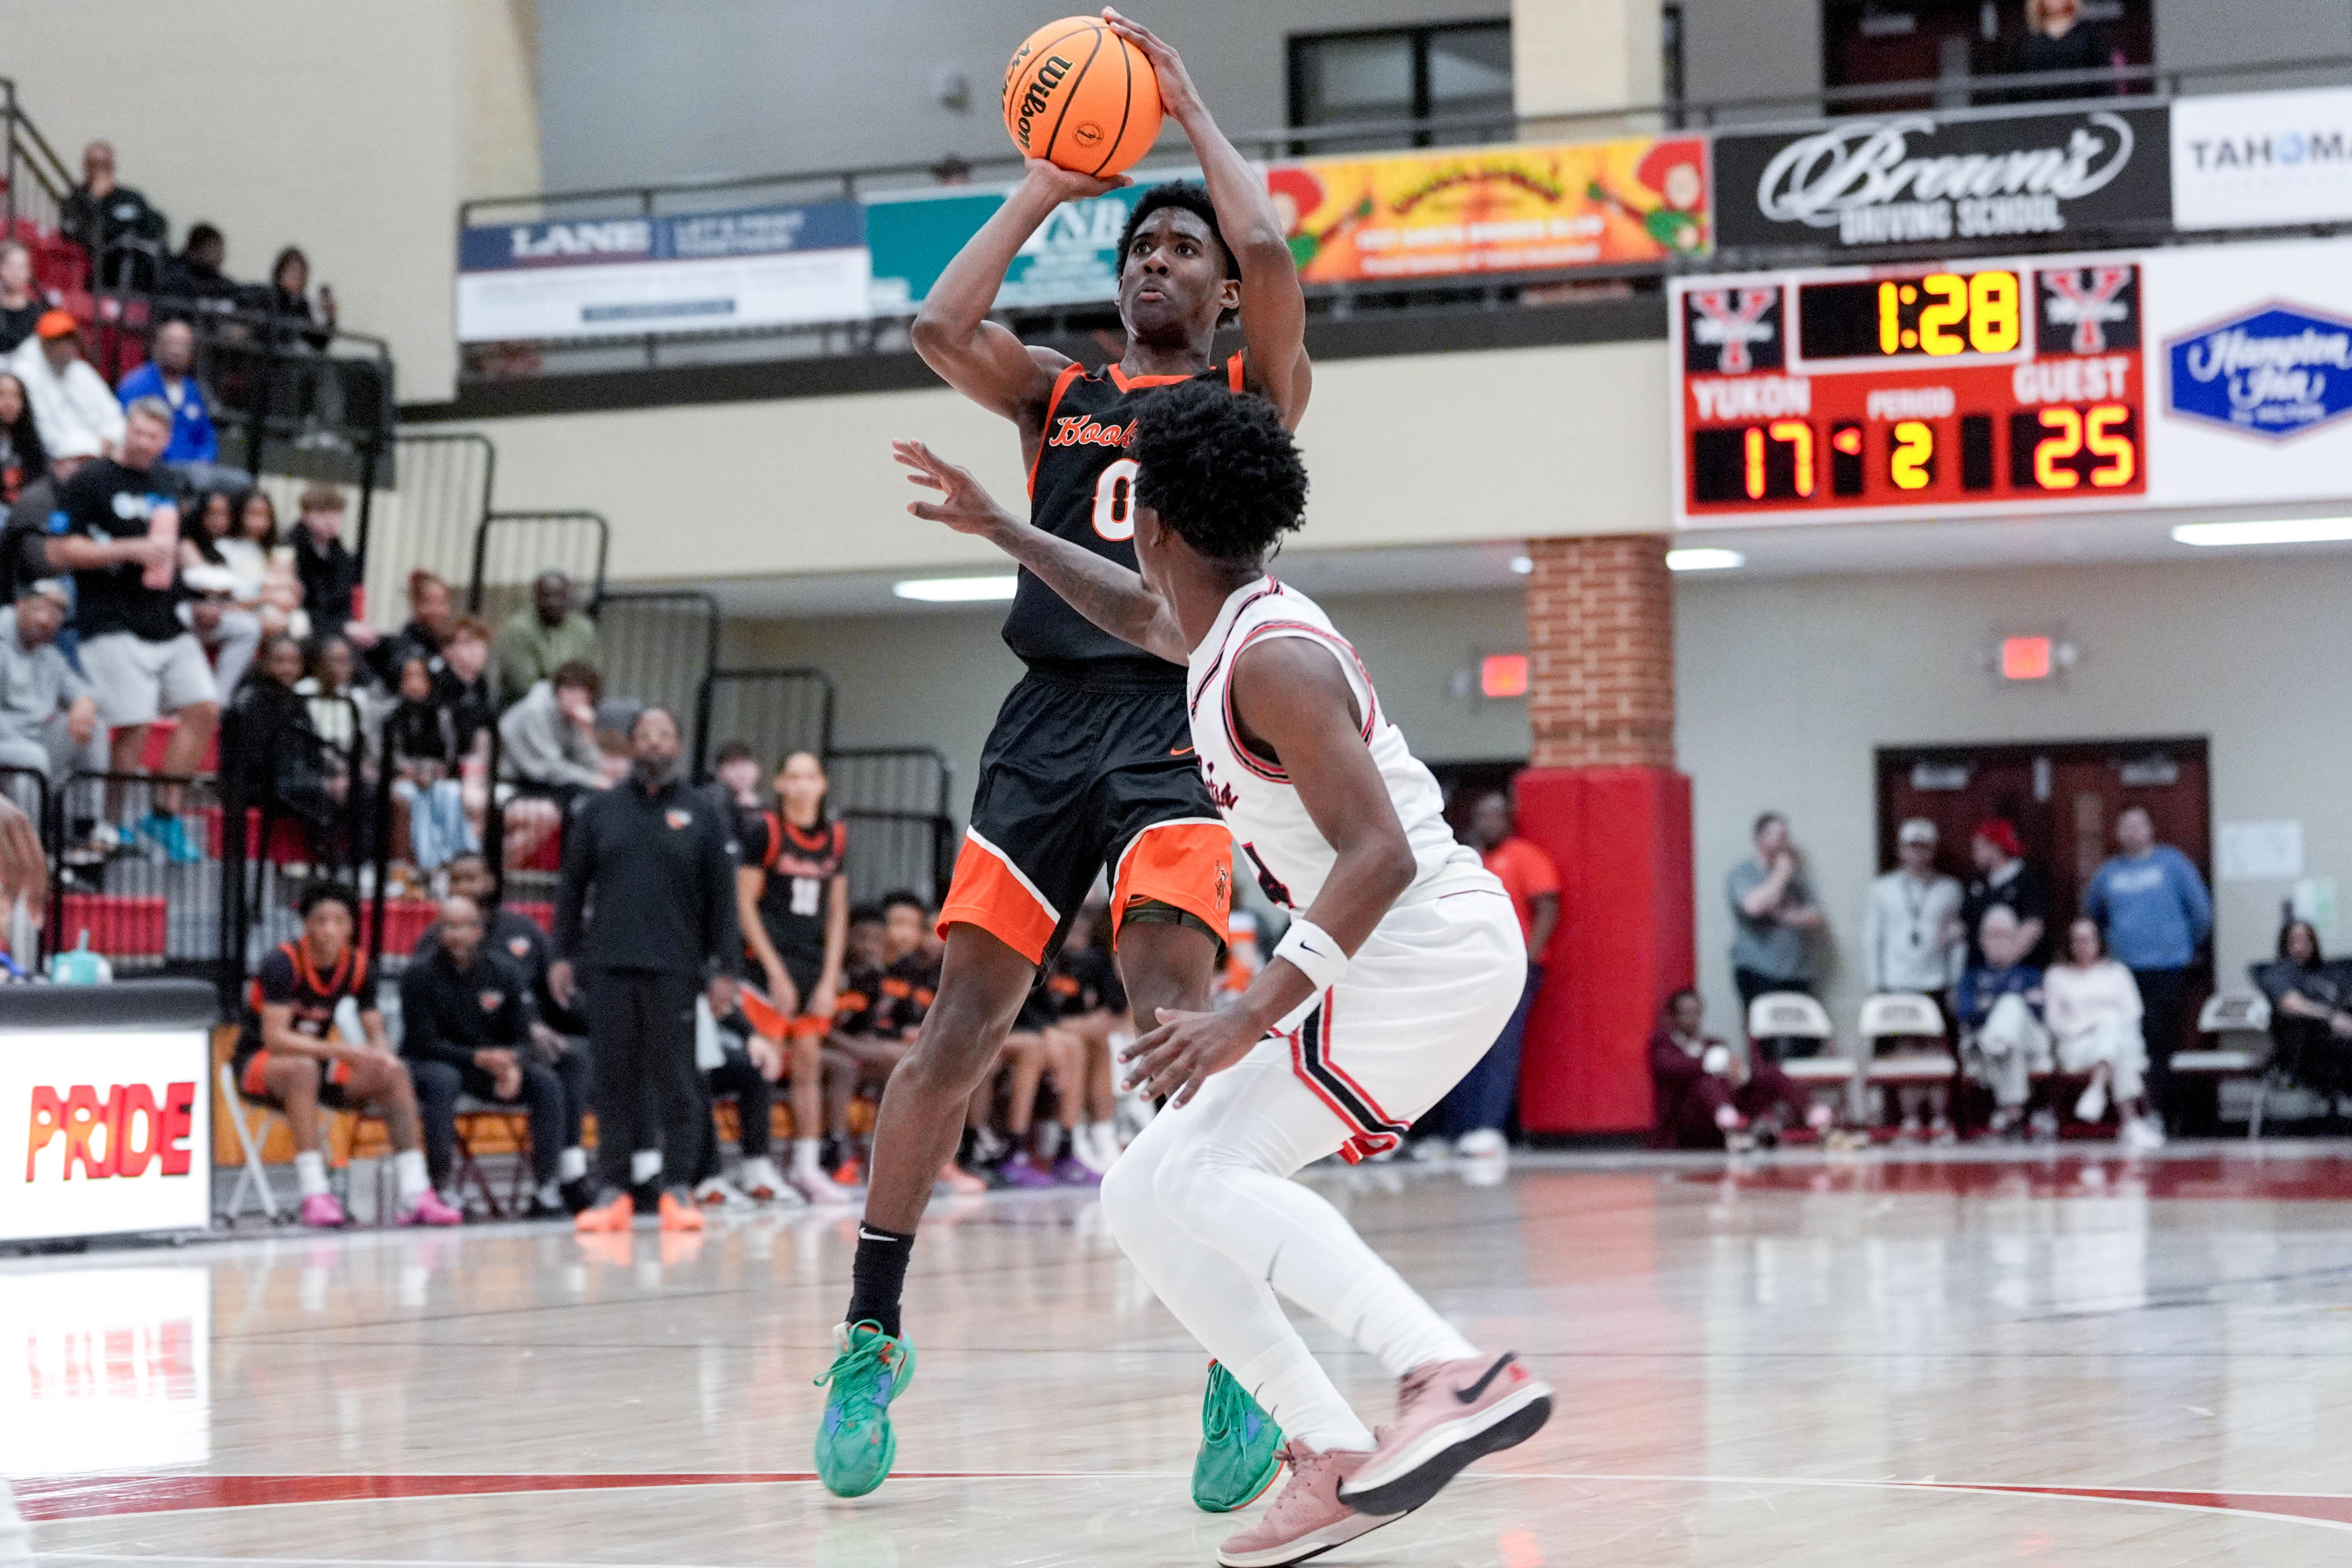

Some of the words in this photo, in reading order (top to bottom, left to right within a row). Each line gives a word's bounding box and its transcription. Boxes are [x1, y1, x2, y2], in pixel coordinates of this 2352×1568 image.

[1018, 55, 1075, 149] Wilson
[2187, 130, 2352, 171] TAHOM
[512, 221, 651, 257] LANE
[1878, 270, 2020, 356] 1:28
[1691, 377, 1811, 421] YUKON
[1866, 386, 1956, 422] PERIOD
[2014, 357, 2129, 404] GUEST
[1049, 414, 1139, 448] Book
[1744, 420, 1815, 500] 17
[1891, 422, 1933, 490] 2
[2034, 404, 2136, 490] 25
[1092, 459, 1141, 541] 0
[26, 1081, 196, 1183] PRIDE
